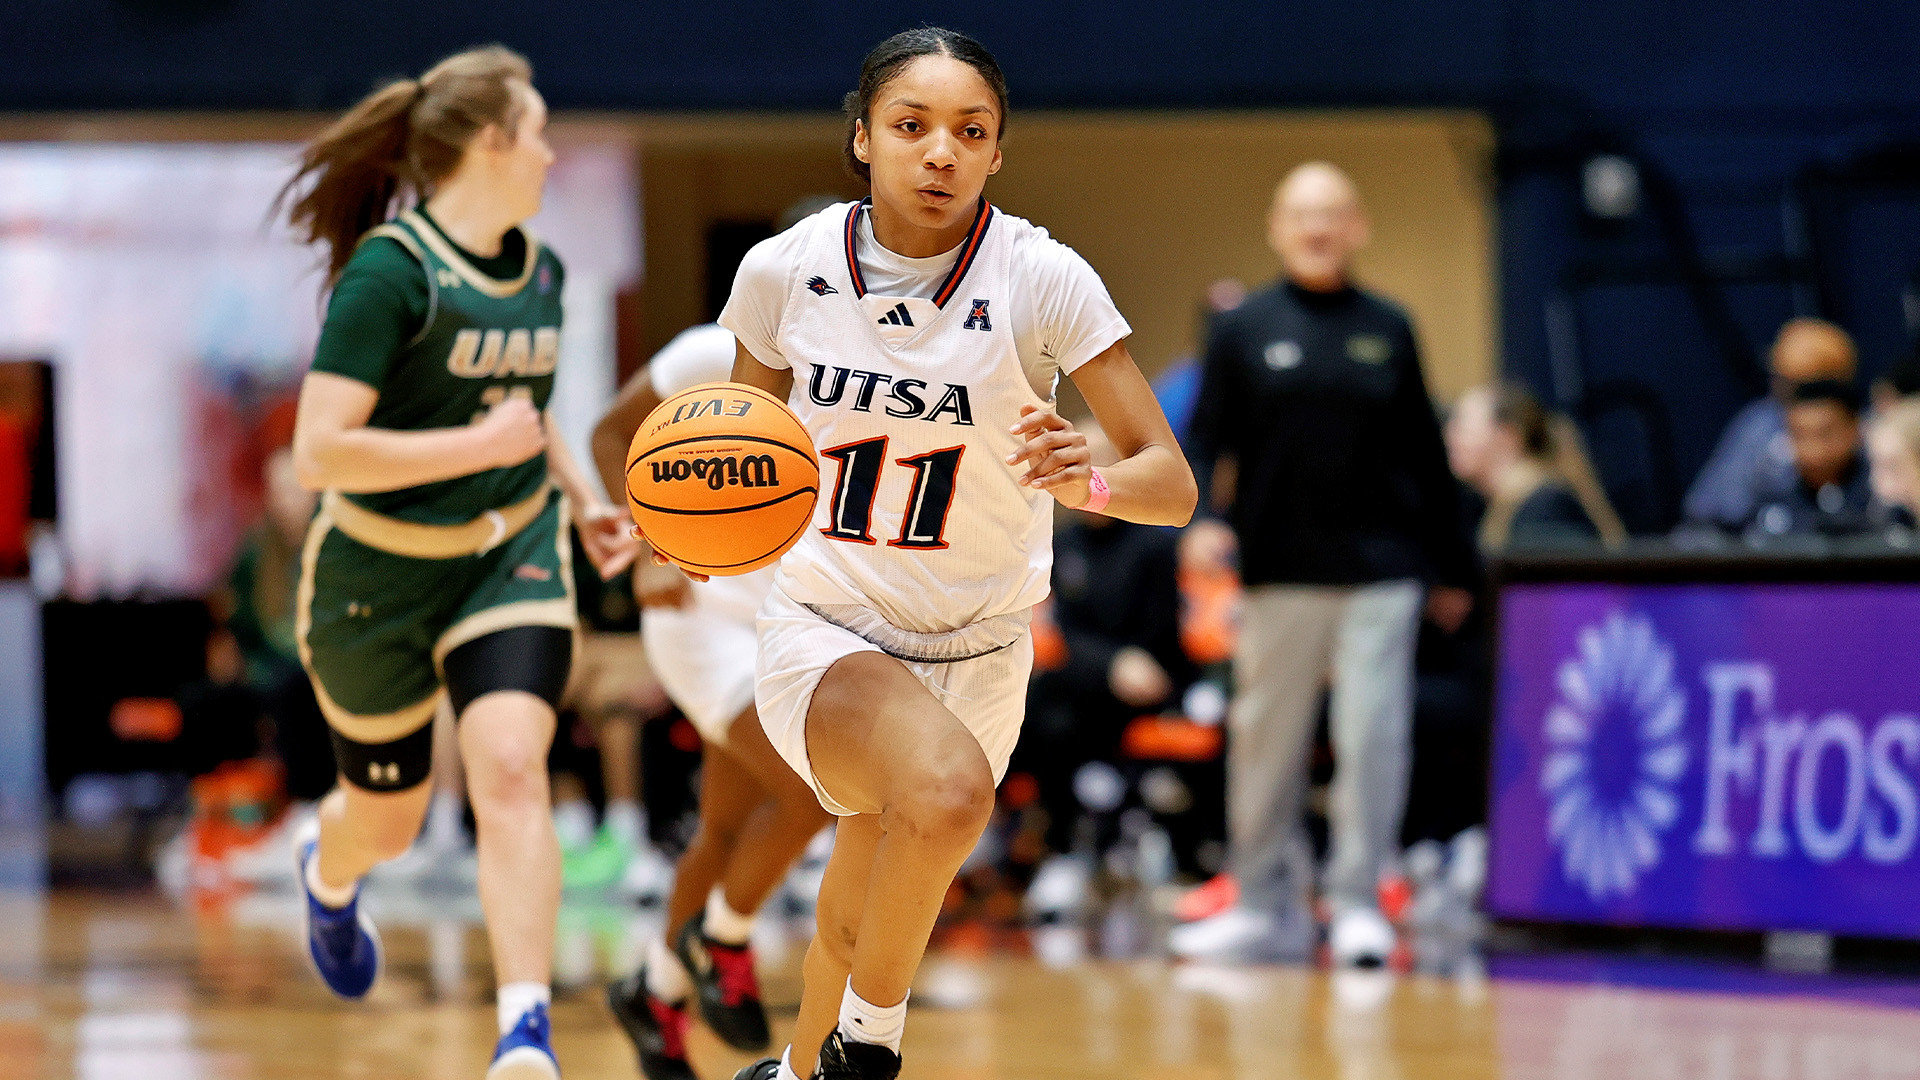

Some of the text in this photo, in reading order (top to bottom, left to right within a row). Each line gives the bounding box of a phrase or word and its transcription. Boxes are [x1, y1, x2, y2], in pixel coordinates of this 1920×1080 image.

[447, 325, 559, 378] UAB
[809, 363, 975, 426] UTSA
[650, 419, 671, 437] NXT
[651, 454, 779, 490] Wilson
[819, 435, 966, 549] 11
[1694, 661, 1920, 863] Fros
